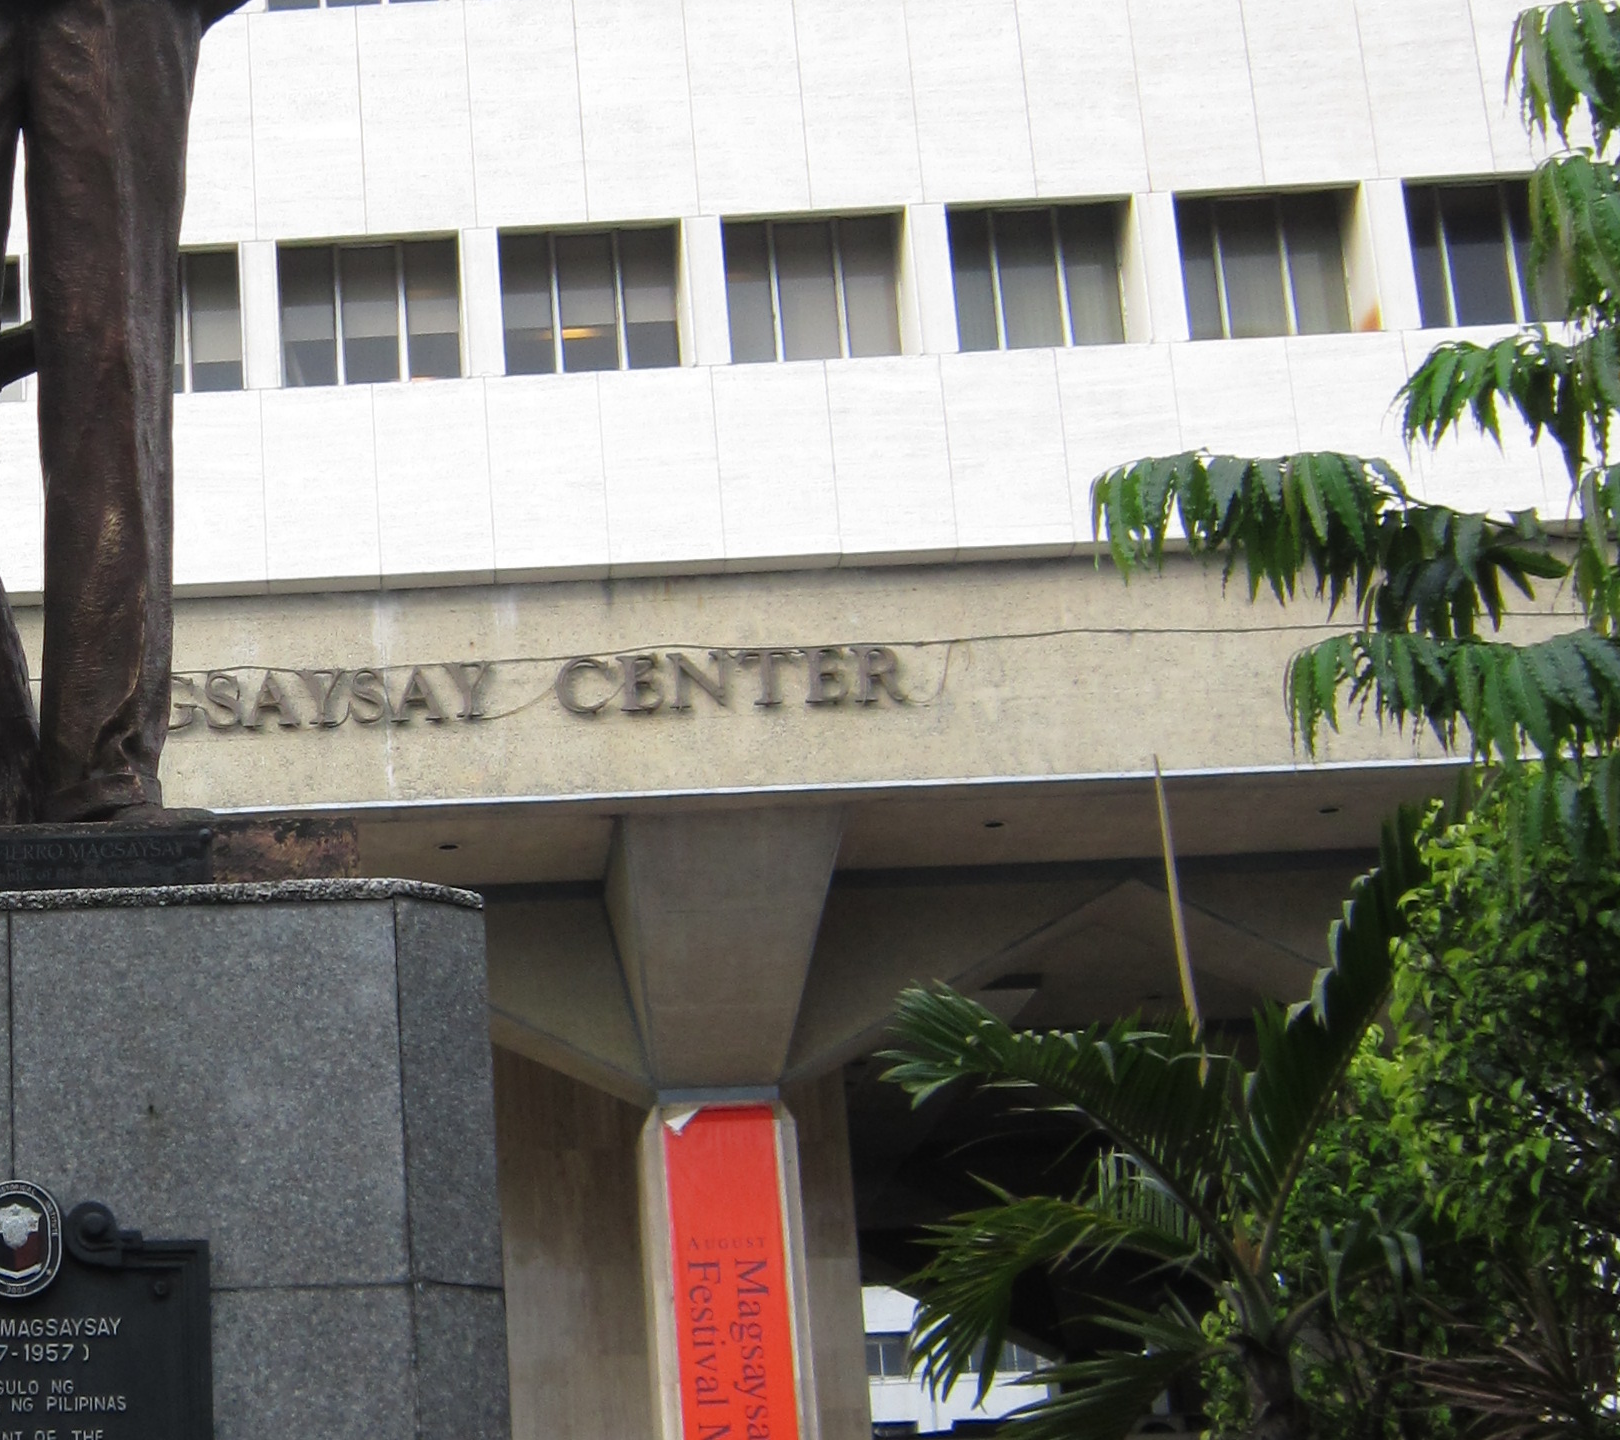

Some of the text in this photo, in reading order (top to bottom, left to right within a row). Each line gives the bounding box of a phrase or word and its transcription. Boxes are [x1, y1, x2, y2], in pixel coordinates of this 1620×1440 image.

[168, 661, 492, 731] GSAYSAY
[554, 646, 910, 714] CENTER
[0, 1317, 122, 1337] MAGSAYSAY
[688, 1261, 730, 1408] Festival
[51, 1379, 75, 1394] NG
[11, 1397, 35, 1412] NG
[46, 1395, 127, 1412] PILIPINAS
